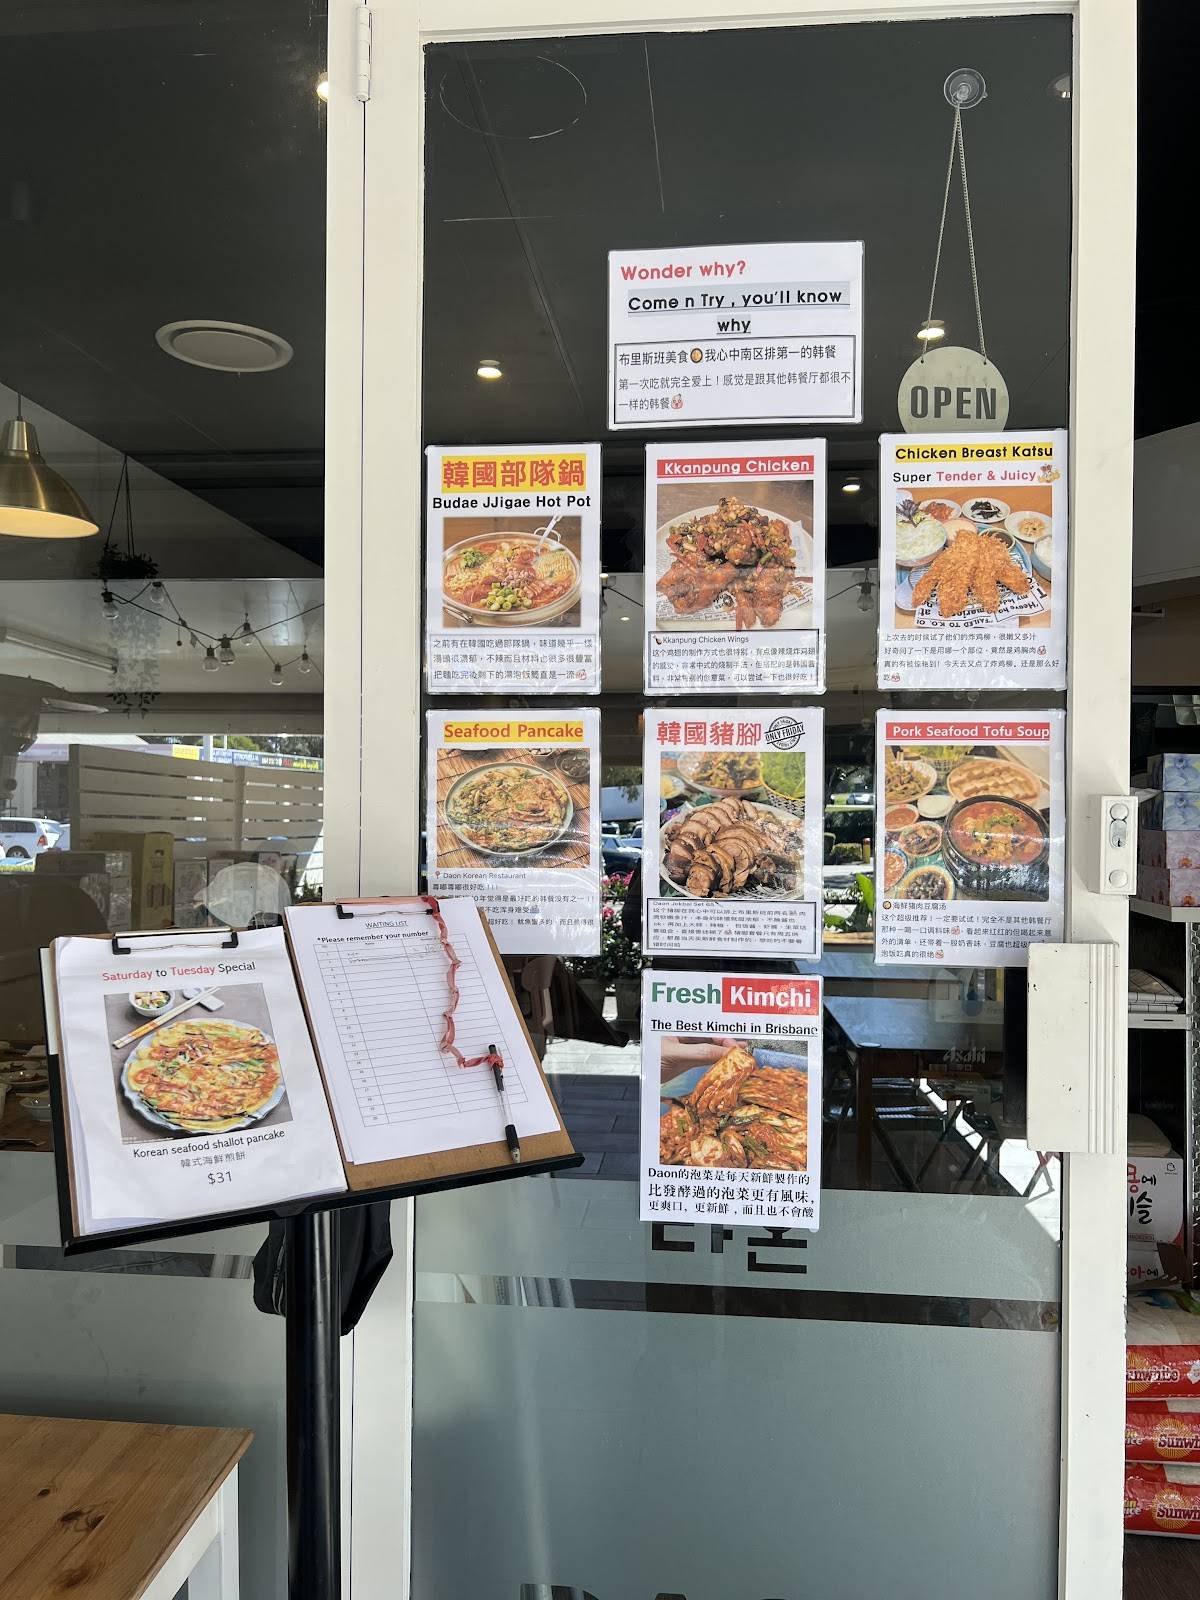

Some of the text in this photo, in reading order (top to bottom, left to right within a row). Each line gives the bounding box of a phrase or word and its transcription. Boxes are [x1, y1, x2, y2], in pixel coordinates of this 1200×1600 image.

[620, 260, 747, 281] Wonder why?
[628, 296, 678, 311] Come
[685, 297, 694, 308] n
[700, 293, 725, 308] Try
[742, 290, 791, 308] you'll
[797, 290, 842, 304] know
[717, 318, 751, 333] why
[619, 397, 670, 411] 一样的韩餐
[910, 385, 997, 420] OPEN
[895, 445, 1053, 460] Chicken Breast Katsu
[443, 459, 585, 489] 韓國部隊鍋
[664, 460, 810, 475] Kkanpung Chicken
[893, 470, 1036, 483] Super Tender & Juicy
[433, 495, 591, 510] Budae JJigae Hot Pot
[662, 636, 697, 645] Kkanpung
[727, 636, 749, 644] Wings
[444, 724, 584, 738] Seafood Pancake
[657, 720, 761, 746] 韓國豬腳
[765, 724, 805, 742] ONLY FRIDAY
[893, 725, 1050, 739] Pork Seafood Tofu Soup
[365, 921, 395, 929] WAITING
[346, 933, 384, 942] remember
[103, 962, 256, 981] Saturday to Tuesday Special
[652, 981, 811, 1008] Fresh Kimchi
[651, 1019, 818, 1035] The Best Kimchi in Brisbane
[133, 1129, 285, 1158] Korean seafood shallot pancake
[207, 1171, 232, 1186] $31
